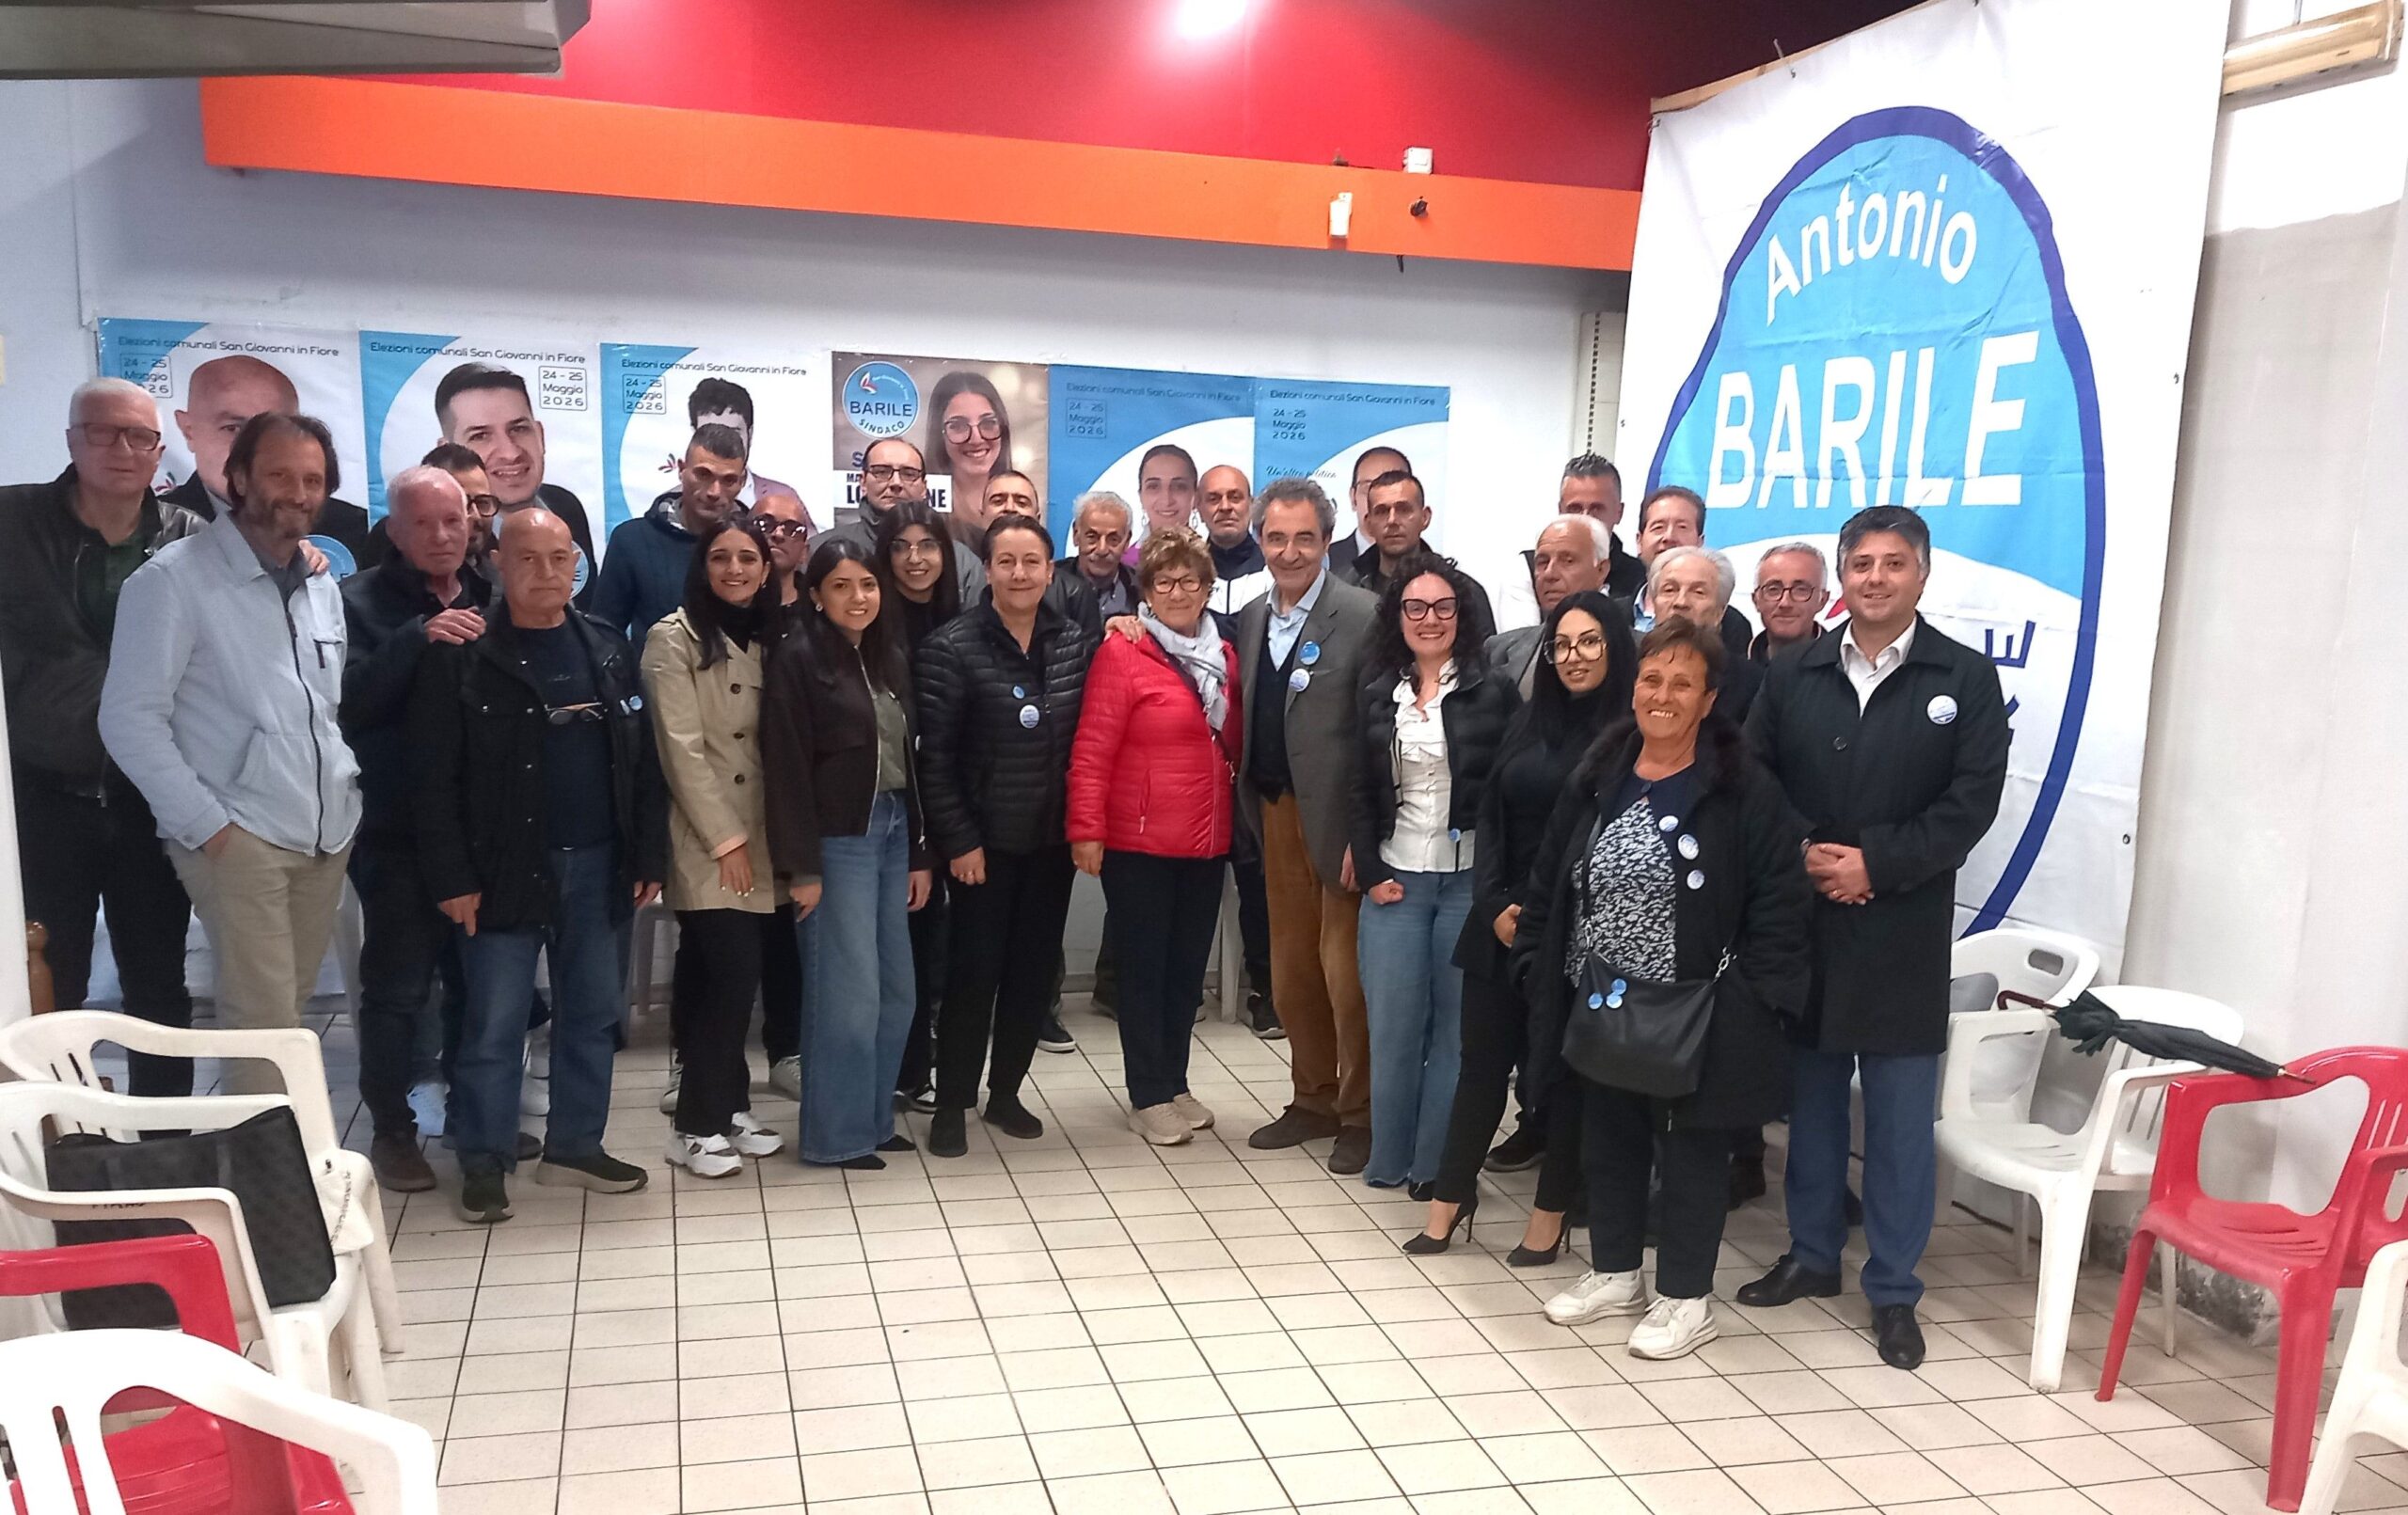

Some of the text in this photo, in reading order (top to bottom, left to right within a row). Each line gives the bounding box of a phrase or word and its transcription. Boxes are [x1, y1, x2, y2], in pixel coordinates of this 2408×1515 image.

[1766, 173, 1978, 327] Antonio
[164, 339, 217, 350] comunali
[219, 340, 243, 352] San
[245, 342, 295, 354] Giovanni
[297, 345, 308, 355] in
[309, 346, 340, 356] Fiore
[370, 341, 586, 364] Elezioni comunali San Giovanni in Fiore
[124, 357, 138, 367] 24
[151, 358, 167, 368] 25
[622, 358, 807, 376] Elezioni comunali San Giovanni in Fiore
[124, 371, 168, 382] Maggio
[543, 370, 557, 379] 24
[568, 371, 583, 381] 25
[626, 378, 639, 387] 24
[650, 379, 662, 387] 25
[542, 383, 583, 395] Maggio
[1147, 387, 1165, 397] San
[1207, 390, 1216, 400] in
[626, 389, 663, 401] Maggio
[1304, 391, 1345, 402] comunali
[1346, 393, 1364, 402] San
[1365, 393, 1402, 404] Giovanni
[1403, 396, 1412, 405] in
[543, 396, 584, 406] 2026
[626, 401, 663, 410] 2026
[1069, 402, 1081, 411] 24
[849, 401, 912, 417] BARILE
[1273, 408, 1285, 417] 24
[1293, 409, 1307, 418] 25
[1069, 414, 1103, 425] Maggio
[1704, 330, 2040, 510] BARILE
[859, 418, 905, 434] SINDACO
[1069, 425, 1103, 434] 2026
[1273, 420, 1307, 431] Maggio
[1273, 431, 1306, 440] 2026
